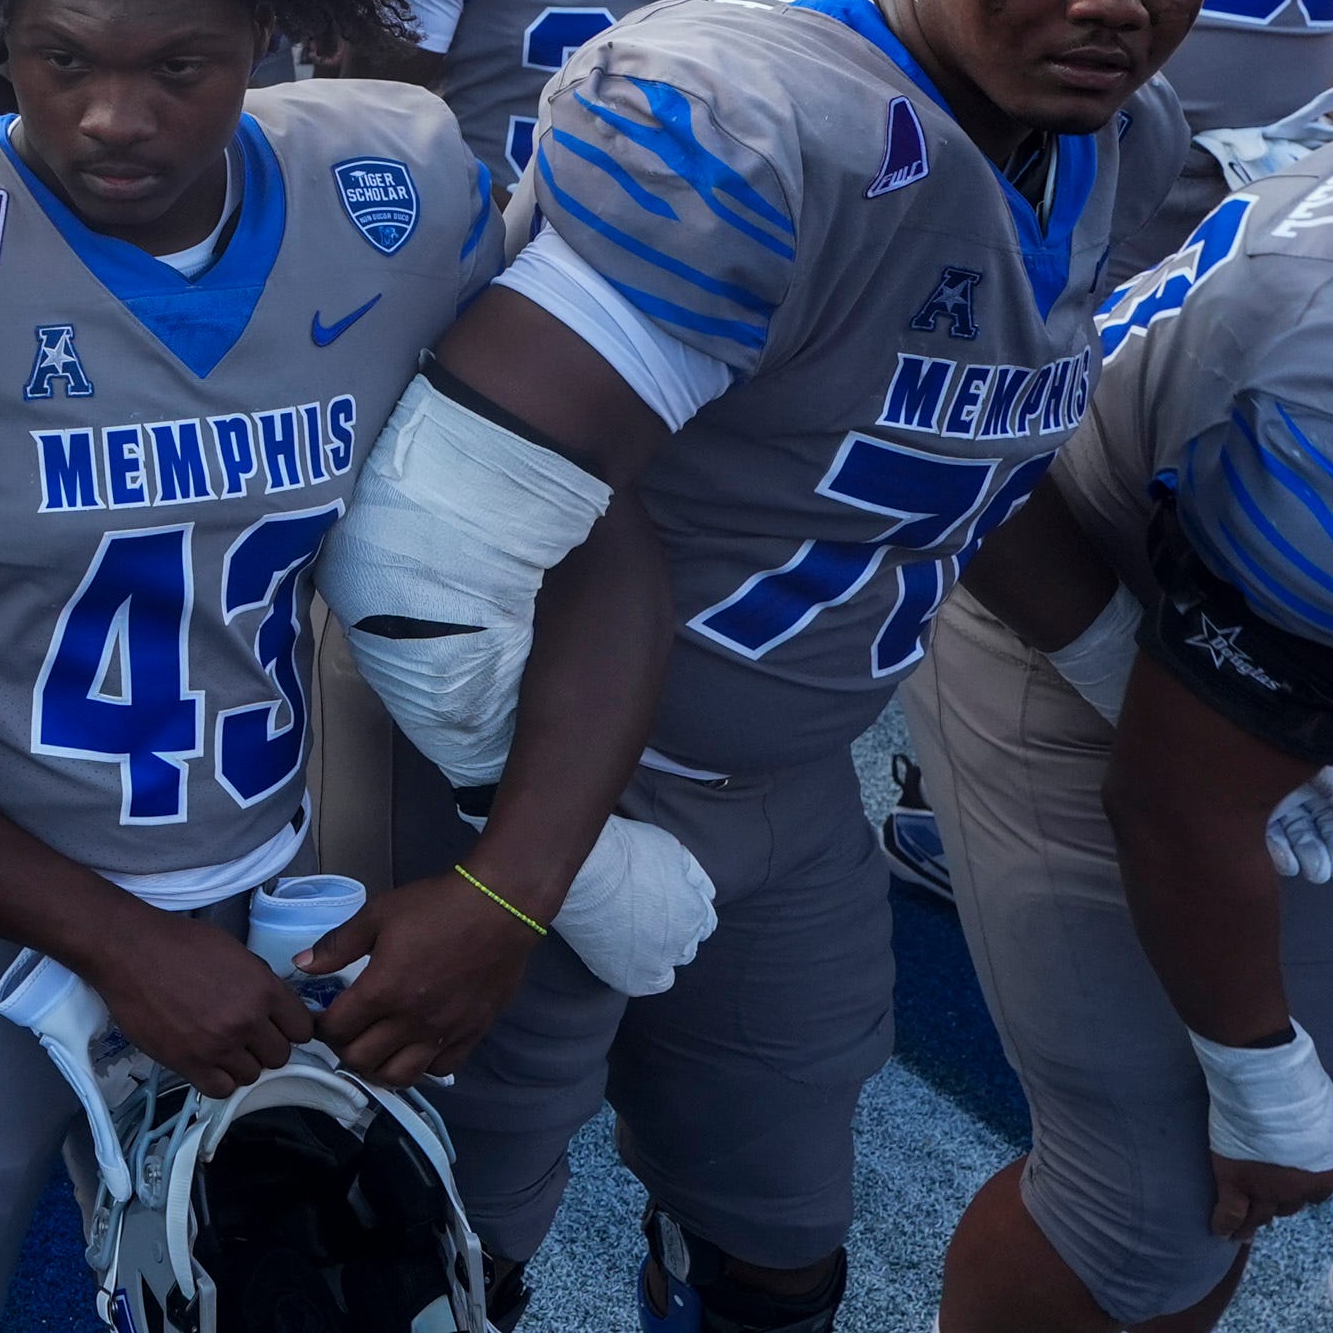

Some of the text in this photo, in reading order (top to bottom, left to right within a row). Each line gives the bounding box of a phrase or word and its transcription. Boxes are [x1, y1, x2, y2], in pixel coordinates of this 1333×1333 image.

[346, 185, 409, 203] SCHOLAR
[358, 172, 396, 188] TIGER
[875, 344, 1092, 442] MEMPHIS
[29, 393, 357, 514] MEMPHIS
[30, 499, 346, 826] 43
